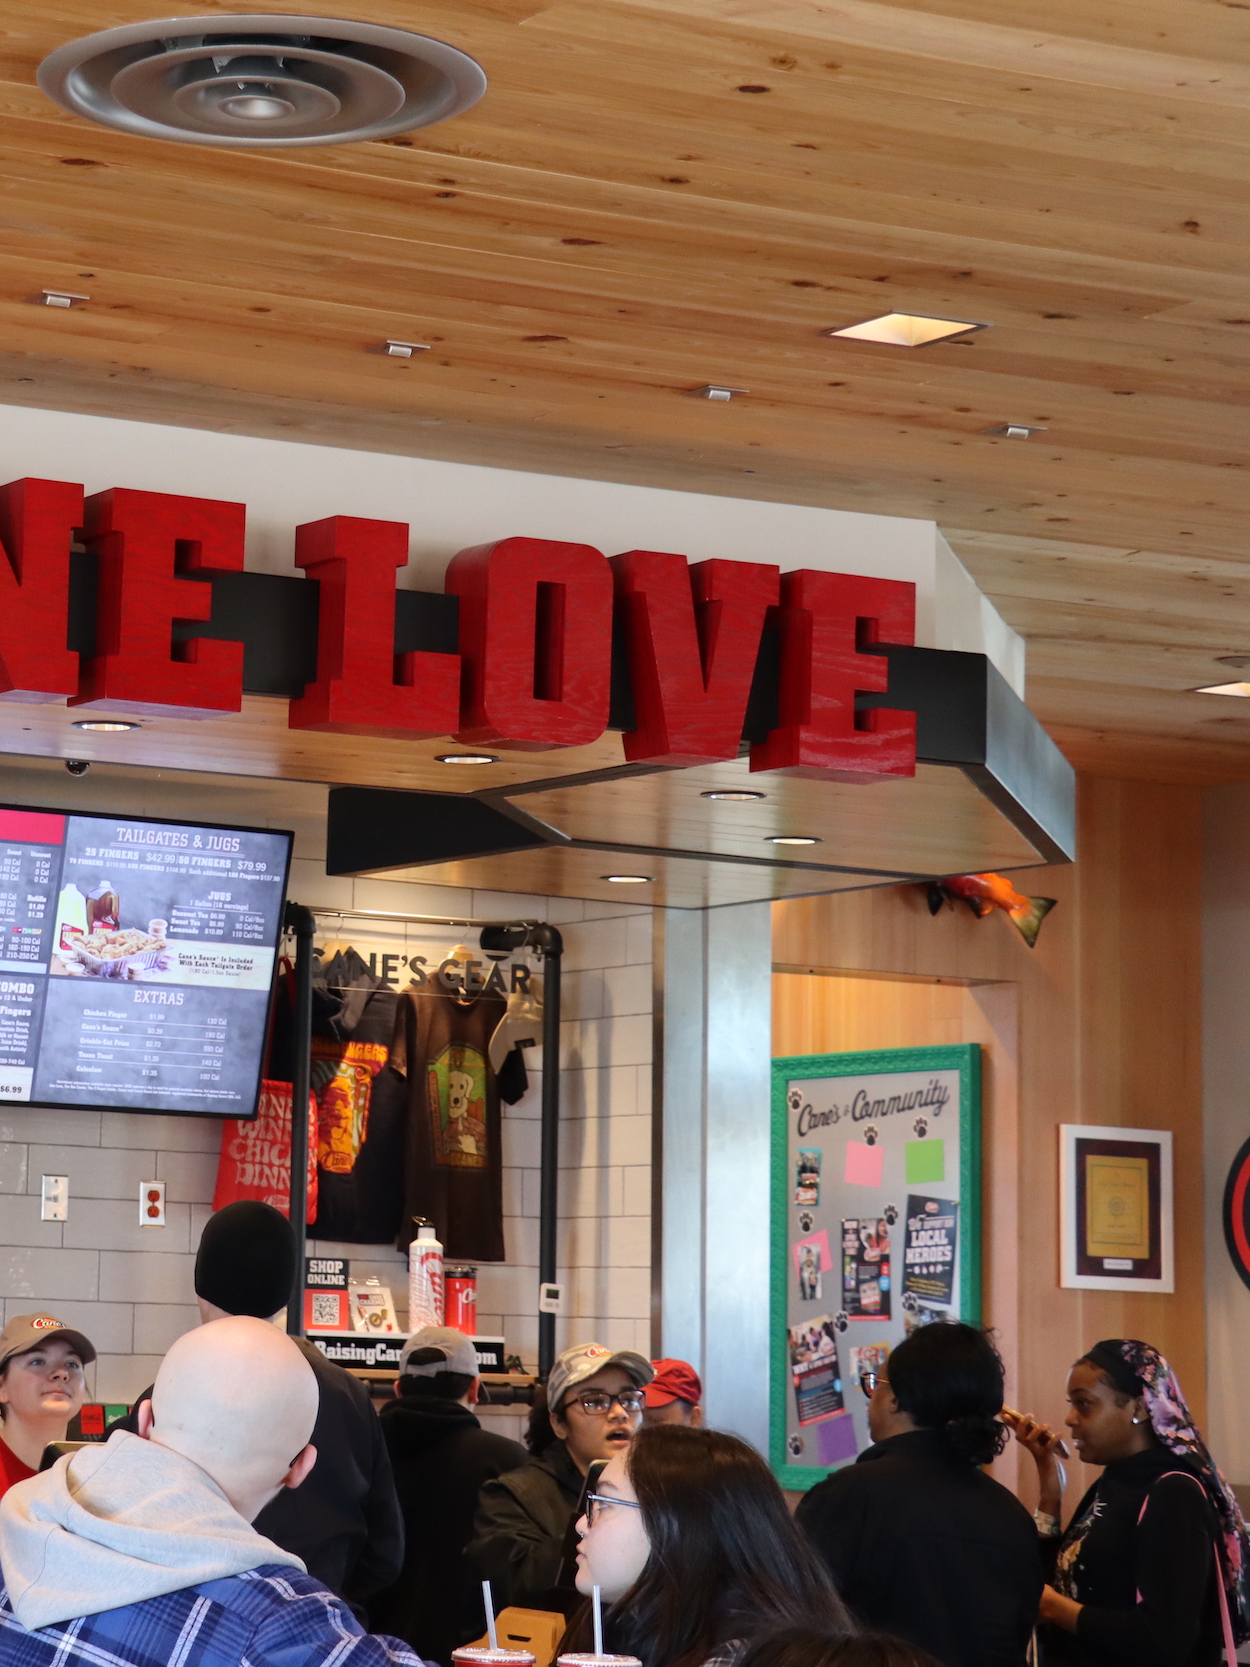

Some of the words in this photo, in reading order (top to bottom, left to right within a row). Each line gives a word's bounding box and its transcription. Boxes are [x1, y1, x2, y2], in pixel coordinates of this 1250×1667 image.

[288, 515, 916, 778] LOVE
[117, 827, 189, 848] TAILGATES
[192, 834, 203, 849] &
[206, 835, 240, 852] JUGS
[85, 847, 96, 857] 25
[99, 848, 140, 861] FINGERS
[146, 852, 175, 864] $42.99
[178, 856, 190, 864] 50
[191, 856, 232, 869] FINGERS
[237, 861, 266, 872] $79.99
[208, 891, 232, 901] JUGS
[211, 962, 234, 970] Tailgate
[439, 958, 531, 995] GEAR
[133, 989, 185, 1006] EXTRAS
[0, 1005, 32, 1017] Fingers
[0, 1085, 22, 1094] $6.99
[797, 1104, 841, 1137] Cane's
[852, 1078, 950, 1122] Community
[911, 1229, 949, 1247] LOCAL
[905, 1245, 952, 1264] HEROES
[309, 1259, 343, 1273] SHOP
[307, 1274, 345, 1286] ONLINE
